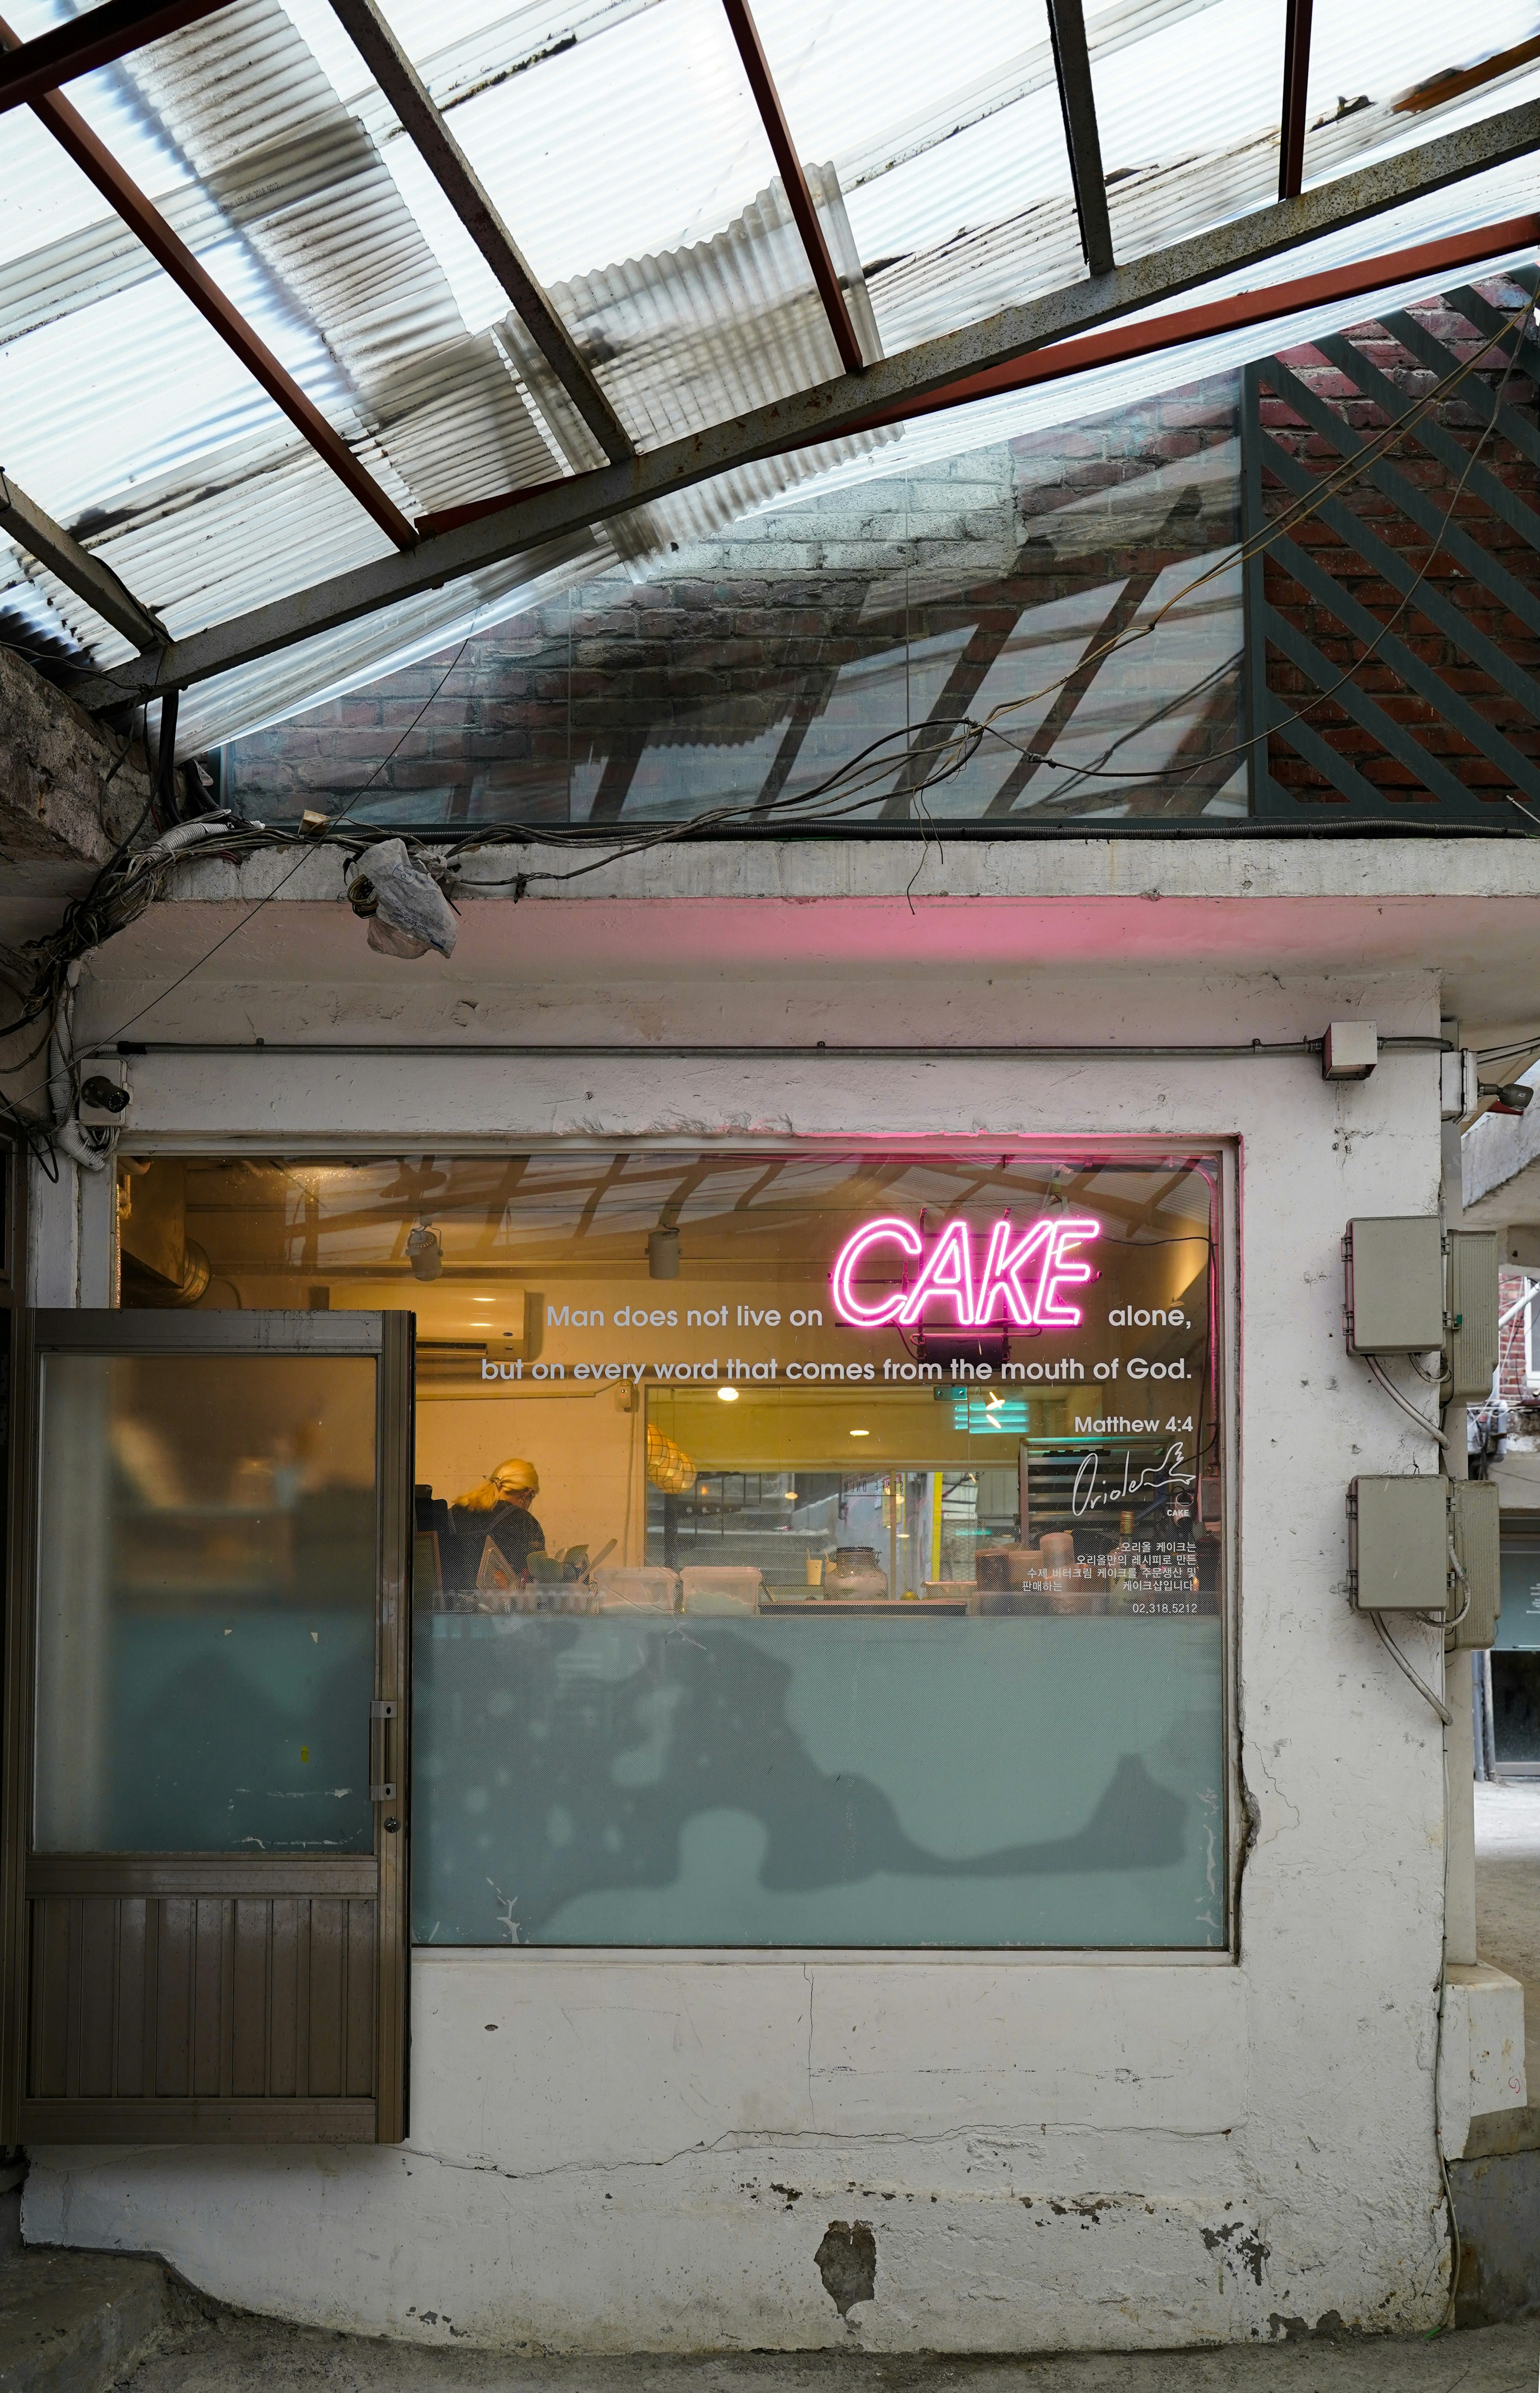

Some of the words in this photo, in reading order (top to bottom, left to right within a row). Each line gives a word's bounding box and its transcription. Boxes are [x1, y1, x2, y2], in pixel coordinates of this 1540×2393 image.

[548, 1306, 604, 1327] Man
[613, 1306, 678, 1327] does
[687, 1306, 728, 1327] not
[738, 1305, 781, 1326] live
[790, 1310, 822, 1326] on
[832, 1218, 1100, 1327] CAKE
[1109, 1305, 1191, 1329] alone,
[482, 1359, 523, 1379] but
[532, 1363, 564, 1379] on
[574, 1363, 646, 1384] every
[654, 1359, 717, 1379] word
[727, 1359, 777, 1379] that
[786, 1363, 875, 1380] comes
[883, 1358, 942, 1379] from
[951, 1359, 992, 1379] the
[1002, 1358, 1084, 1379] mouth
[1094, 1358, 1119, 1379] of
[1127, 1358, 1191, 1379] God.
[1075, 1416, 1160, 1433] Matthew
[1165, 1416, 1193, 1432] 4:4
[1121, 1542, 1151, 1553] 오리올
[1156, 1542, 1196, 1553] 케이크는
[1076, 1555, 1126, 1566] 오리올만의
[1132, 1555, 1171, 1565] 레시피로
[1177, 1555, 1196, 1565] 만든
[1027, 1568, 1047, 1579] 수제
[1052, 1568, 1091, 1579] 버터크림
[1097, 1568, 1136, 1579] 케이크를
[1142, 1567, 1182, 1579] 주문생산
[1188, 1567, 1196, 1578] 및
[1022, 1581, 1062, 1591] 판매하는
[1132, 1603, 1197, 1614] 02.318.5212
